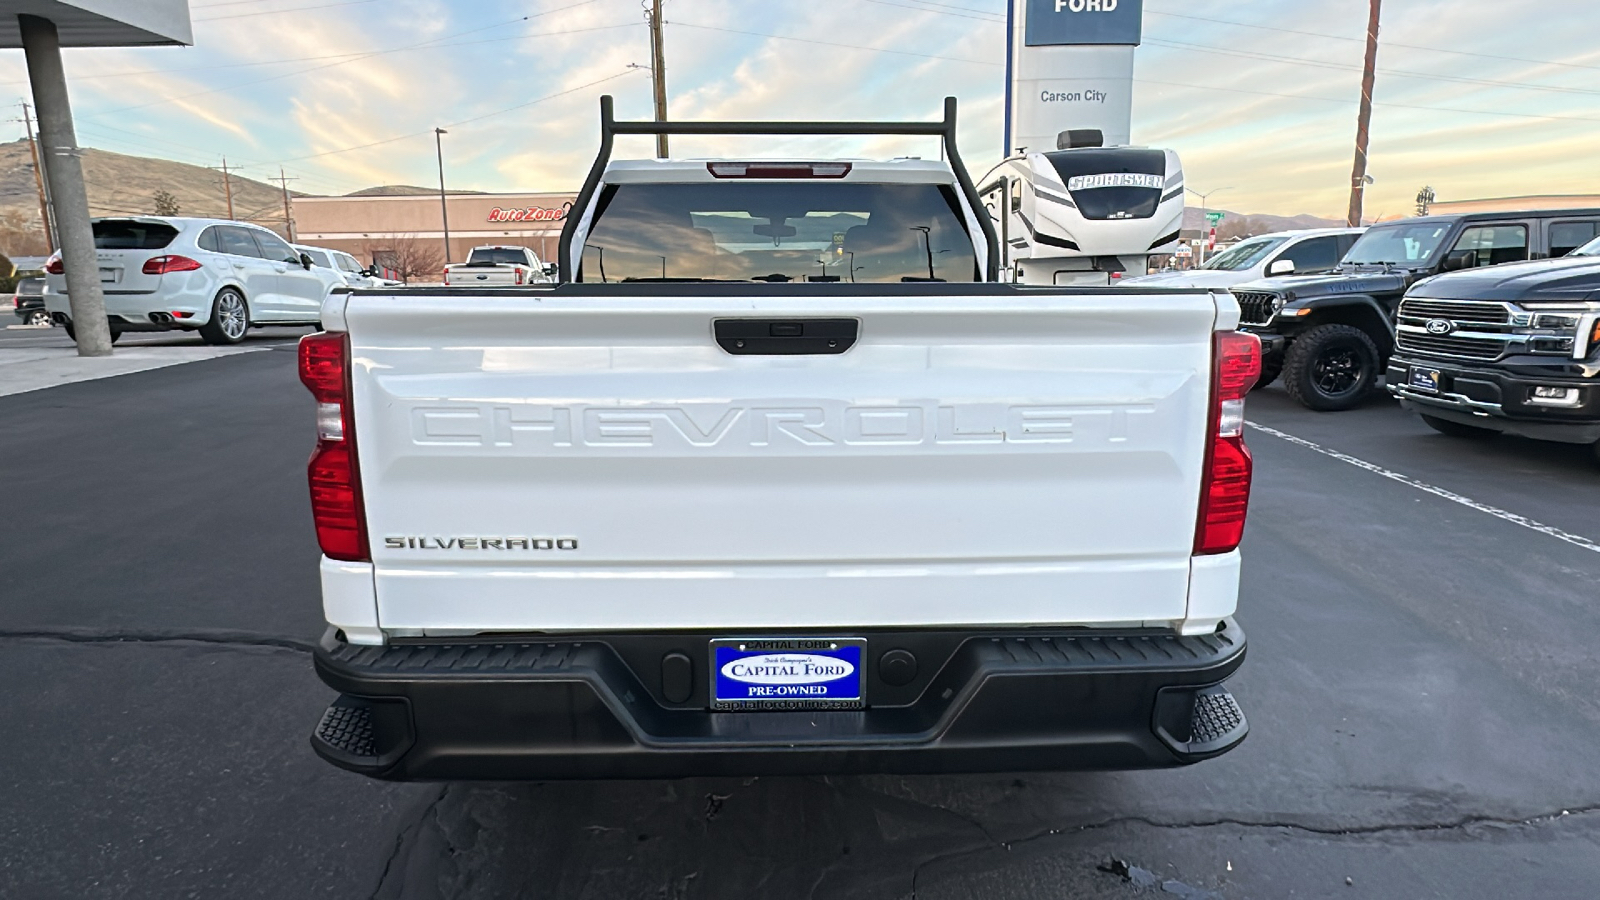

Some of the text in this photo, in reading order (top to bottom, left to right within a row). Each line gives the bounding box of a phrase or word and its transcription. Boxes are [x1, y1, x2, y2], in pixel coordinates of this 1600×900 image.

[1054, 0, 1118, 12] FORD
[1041, 90, 1107, 103] Carson City
[1069, 173, 1164, 191] SPORTSMEN
[487, 206, 564, 222] AutoZone
[411, 403, 1155, 447] CHEVROLET
[384, 536, 579, 551] SILVERADO
[746, 640, 831, 649] CAPITAL FORD
[748, 686, 828, 696] PRE-OWNED
[714, 700, 862, 711] capitalfordonline.com
